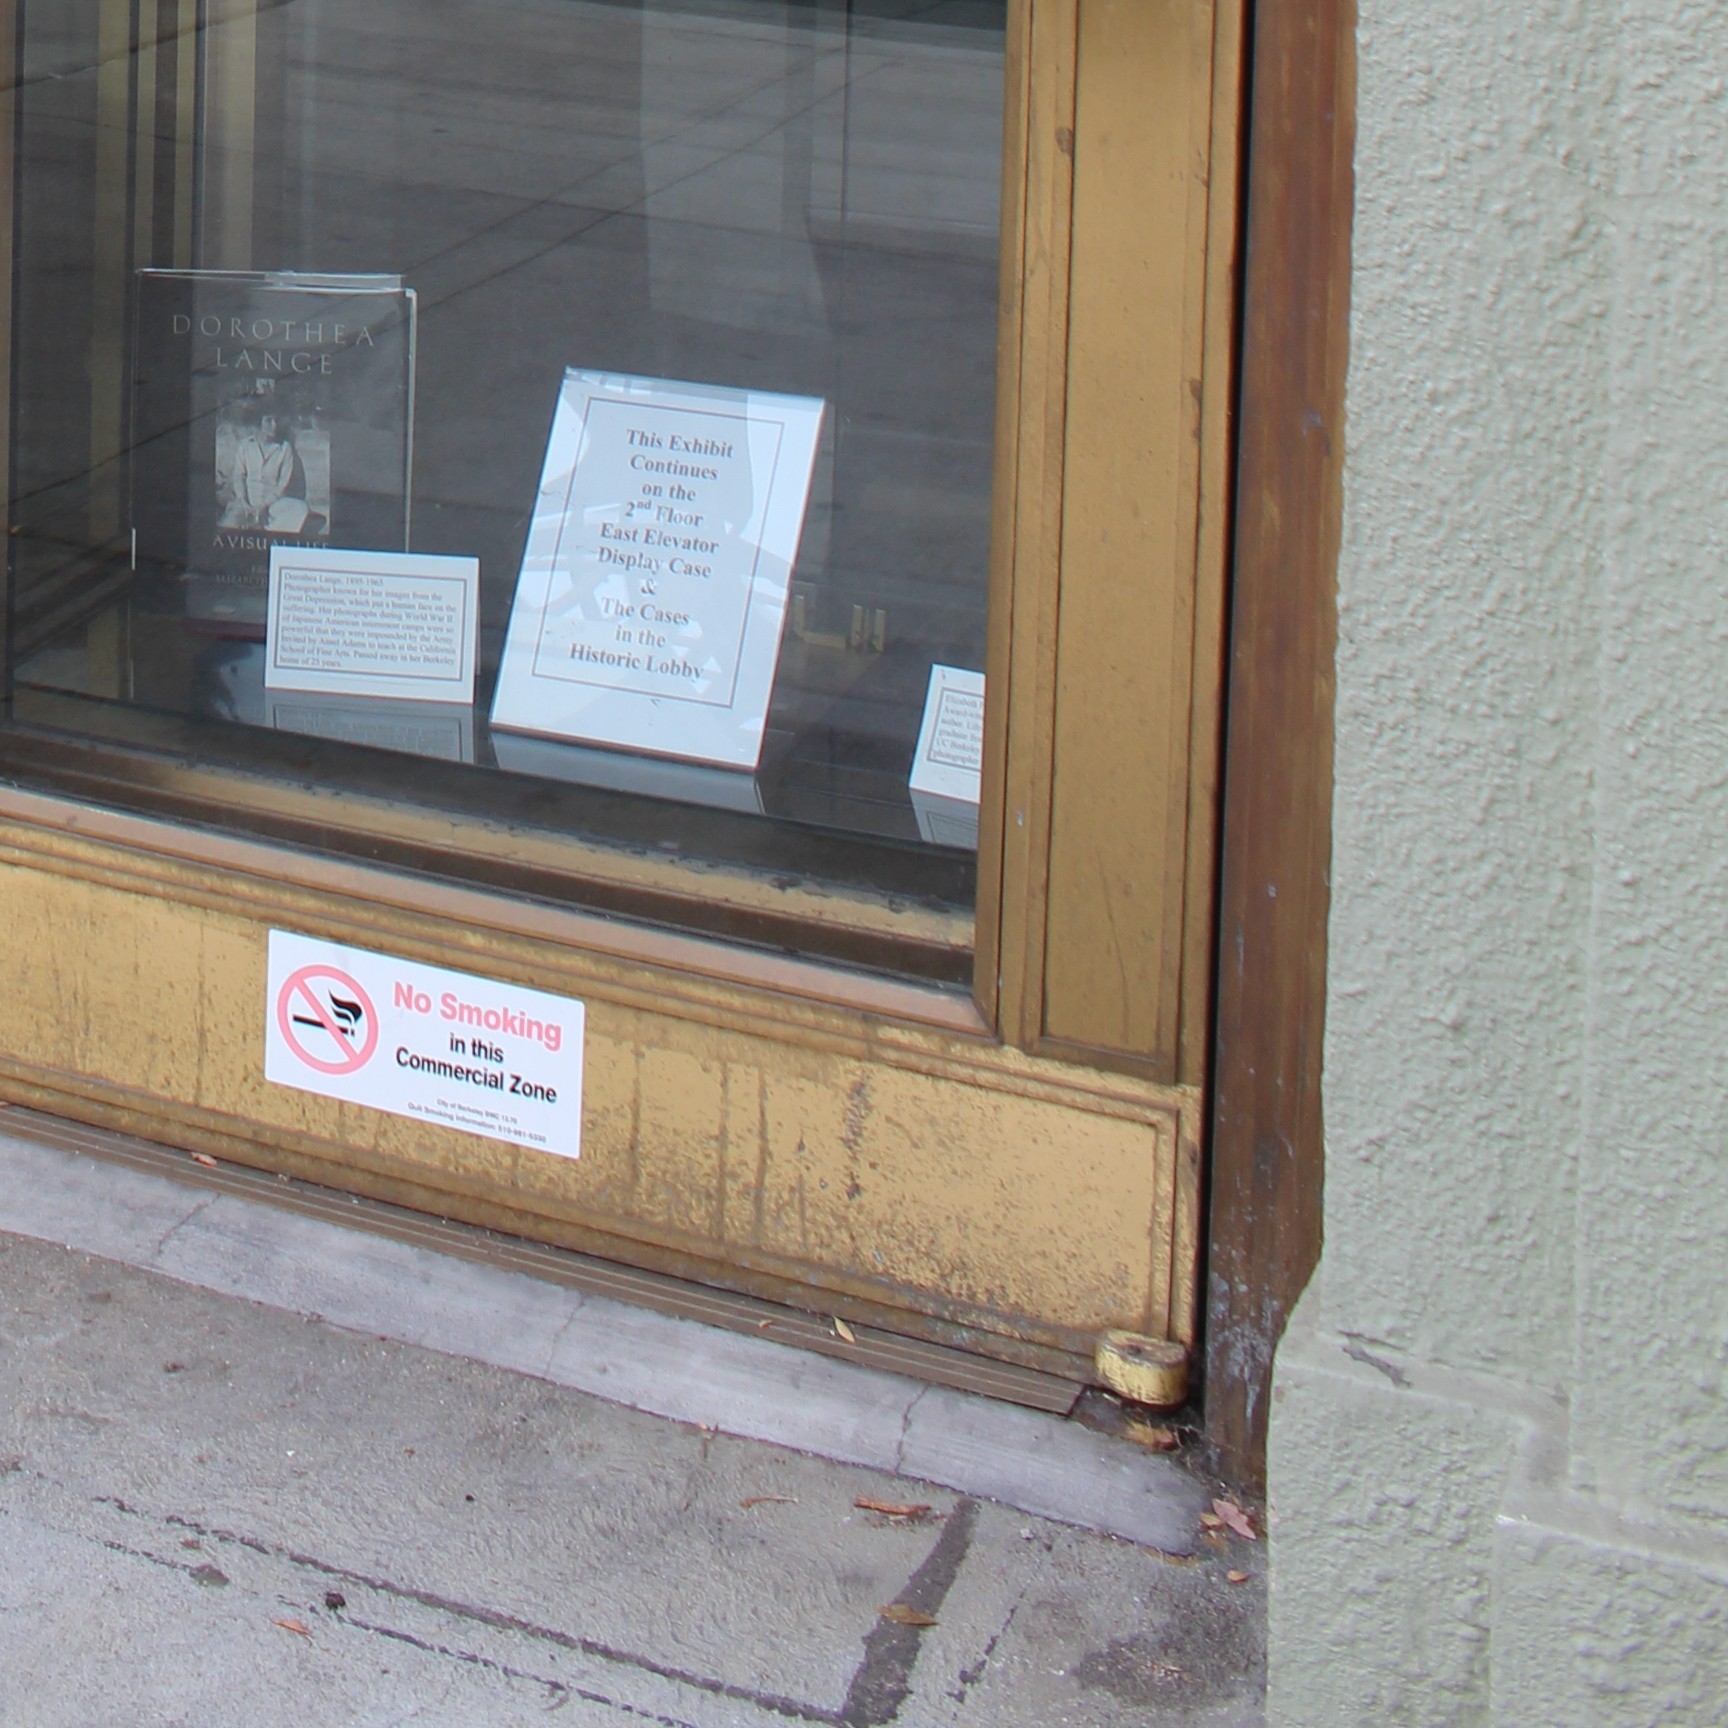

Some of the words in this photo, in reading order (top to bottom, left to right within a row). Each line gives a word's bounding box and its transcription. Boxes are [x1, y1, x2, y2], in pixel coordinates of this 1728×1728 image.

[173, 314, 374, 346] DOROTHEA
[216, 347, 332, 374] LANGE
[626, 429, 663, 449] This
[669, 434, 734, 459] Exhibit
[630, 455, 719, 480] Continues
[642, 483, 663, 497] on
[669, 483, 696, 502] the
[624, 499, 652, 518] 2nd
[656, 506, 703, 528] Floor
[600, 522, 638, 544] East
[643, 528, 719, 554] Elevator
[598, 546, 664, 575] Display
[669, 557, 711, 578] Case
[285, 572, 316, 582] Dorothea
[640, 578, 657, 596] &
[283, 593, 302, 602] Great
[348, 598, 369, 606] which
[391, 601, 415, 609] human
[417, 602, 432, 610] face
[445, 604, 456, 612] the
[284, 583, 331, 595] Photographer
[332, 586, 357, 595] known
[359, 588, 369, 596] for
[370, 589, 383, 597] her
[385, 590, 409, 600] images
[411, 592, 429, 600] from
[430, 593, 441, 601] the
[291, 615, 322, 625] Japanese
[325, 617, 359, 626] American
[318, 606, 331, 614] Her
[333, 607, 376, 619] photographs
[379, 610, 402, 620] during
[404, 612, 427, 621] World
[429, 614, 444, 622] War
[602, 596, 635, 617] The
[639, 604, 690, 626] Cases
[281, 625, 313, 635] powerful
[315, 627, 328, 635] that
[330, 628, 345, 637] they
[419, 634, 430, 642] the
[616, 625, 632, 642] in
[638, 628, 666, 648] the
[280, 645, 304, 654] School
[353, 650, 377, 659] Passed
[409, 654, 421, 662] her
[422, 655, 454, 665] Berkeley
[342, 639, 366, 648] Adams
[377, 642, 396, 650] teach
[419, 645, 456, 654] California
[570, 643, 640, 670] Historic
[646, 655, 704, 682] Lobby
[394, 981, 432, 1014] No
[440, 992, 561, 1052] Smoking
[449, 1032, 466, 1055] in
[471, 1038, 504, 1063] this
[396, 1046, 504, 1091] Commercial
[509, 1073, 558, 1104] Zone
[424, 1105, 454, 1121] Smoking
[455, 1112, 496, 1130] Information:
[437, 1098, 448, 1109] City
[450, 1101, 456, 1109] of
[457, 1102, 484, 1117] Berkeley
